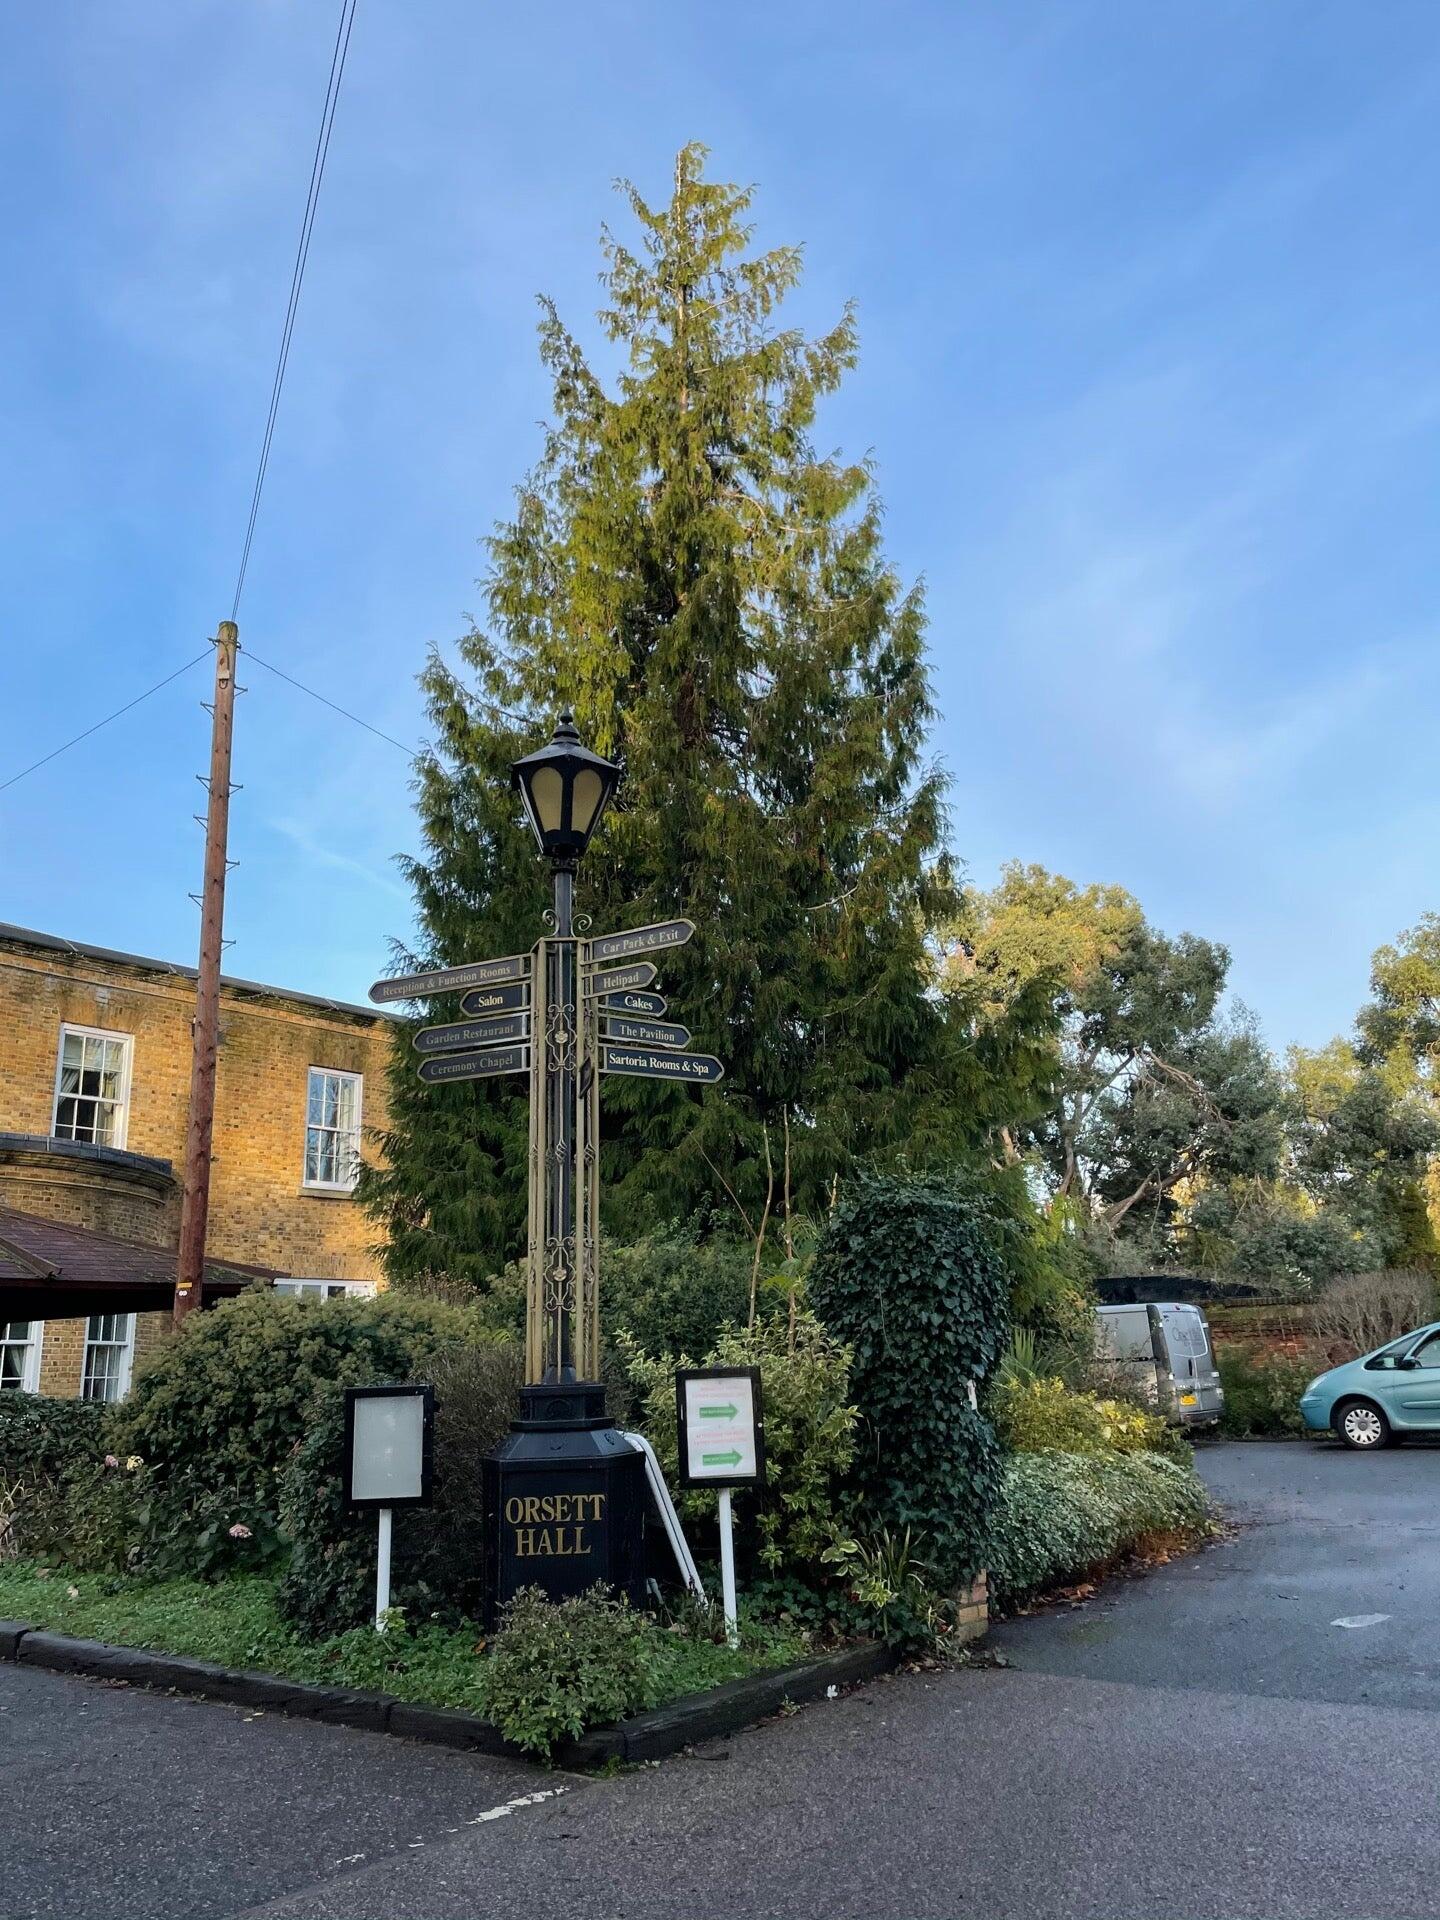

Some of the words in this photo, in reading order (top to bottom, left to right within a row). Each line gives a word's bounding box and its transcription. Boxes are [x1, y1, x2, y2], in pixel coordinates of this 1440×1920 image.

[602, 942, 620, 954] Car
[623, 936, 646, 950] Park
[647, 933, 656, 945] &
[659, 929, 679, 942] Exit
[383, 983, 425, 996] Reception
[427, 979, 436, 989] &
[438, 973, 477, 986] Function
[480, 966, 511, 979] Rooms
[603, 972, 639, 988] Helipad
[478, 996, 503, 1008] Salon
[624, 996, 653, 1010] Cakes
[426, 1034, 460, 1045] Garden
[463, 1024, 514, 1039] Restaurant
[619, 1024, 637, 1036] The
[639, 1028, 675, 1042] Pavilion
[430, 1061, 478, 1075] Ceremony
[479, 1054, 513, 1069] Chapel
[609, 1053, 647, 1067] Sartoria
[649, 1057, 680, 1071] Rooms
[682, 1061, 691, 1072] &
[692, 1062, 709, 1075] Spa
[505, 1494, 606, 1524] ORSETT
[515, 1526, 592, 1556] HALL
